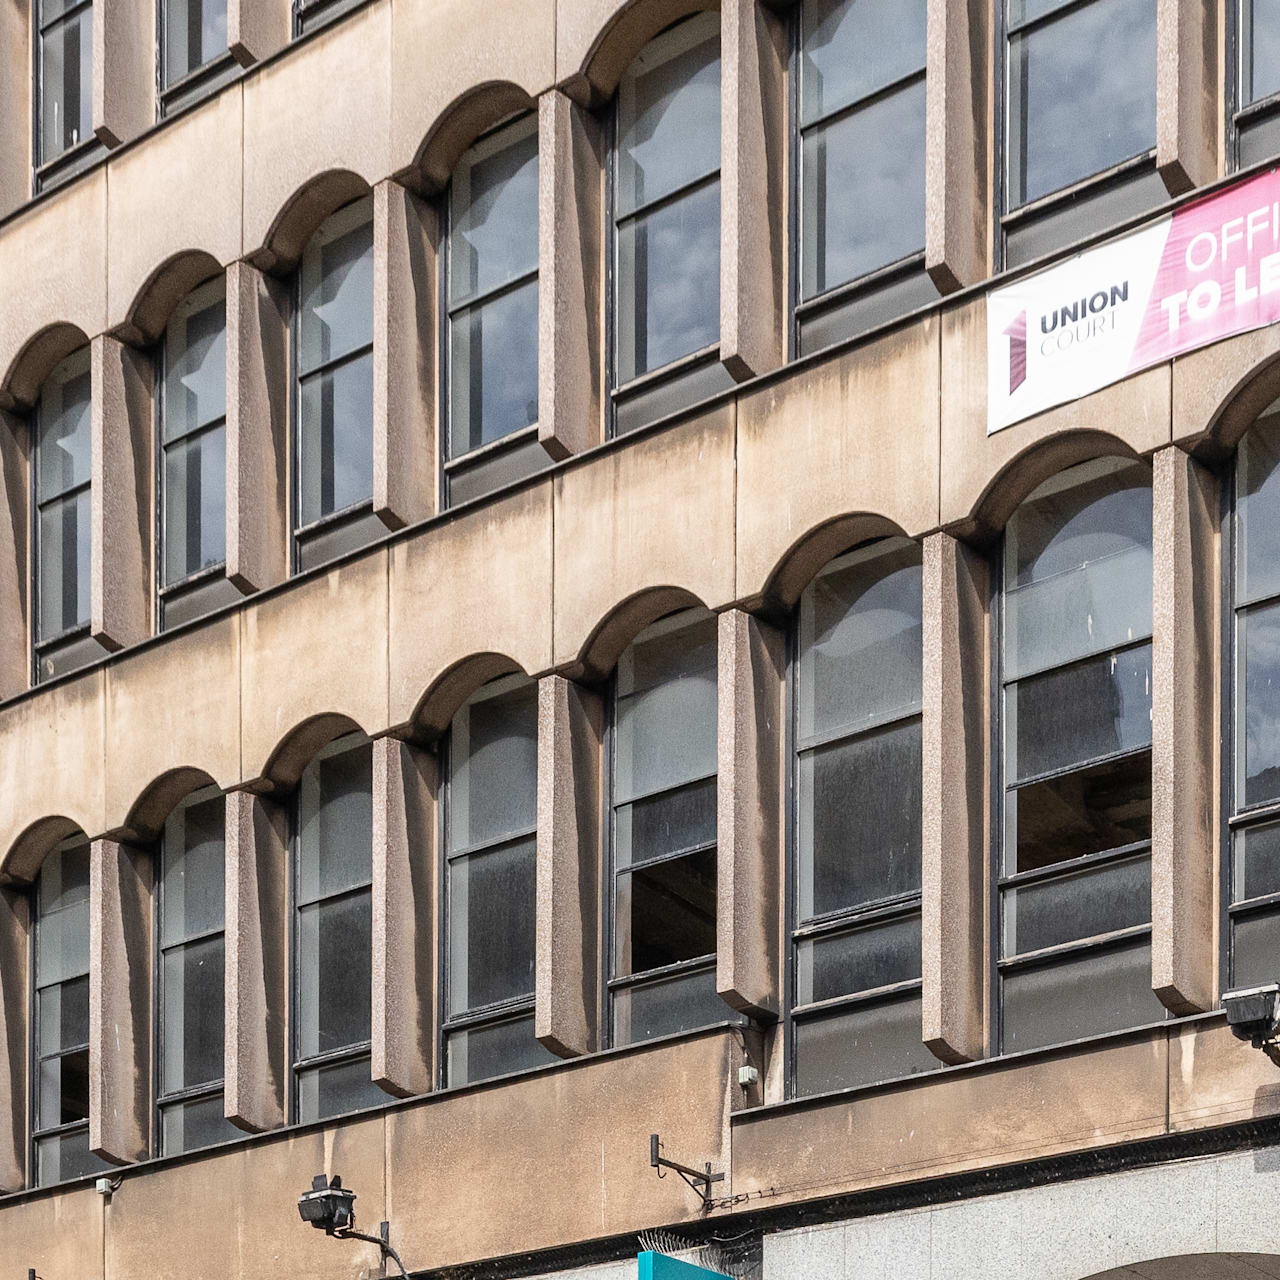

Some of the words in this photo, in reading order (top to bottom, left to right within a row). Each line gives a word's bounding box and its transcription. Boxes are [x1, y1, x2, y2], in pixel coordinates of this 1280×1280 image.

[1040, 280, 1129, 335] UNION
[1161, 280, 1221, 333] TO
[1040, 309, 1119, 358] COURT
